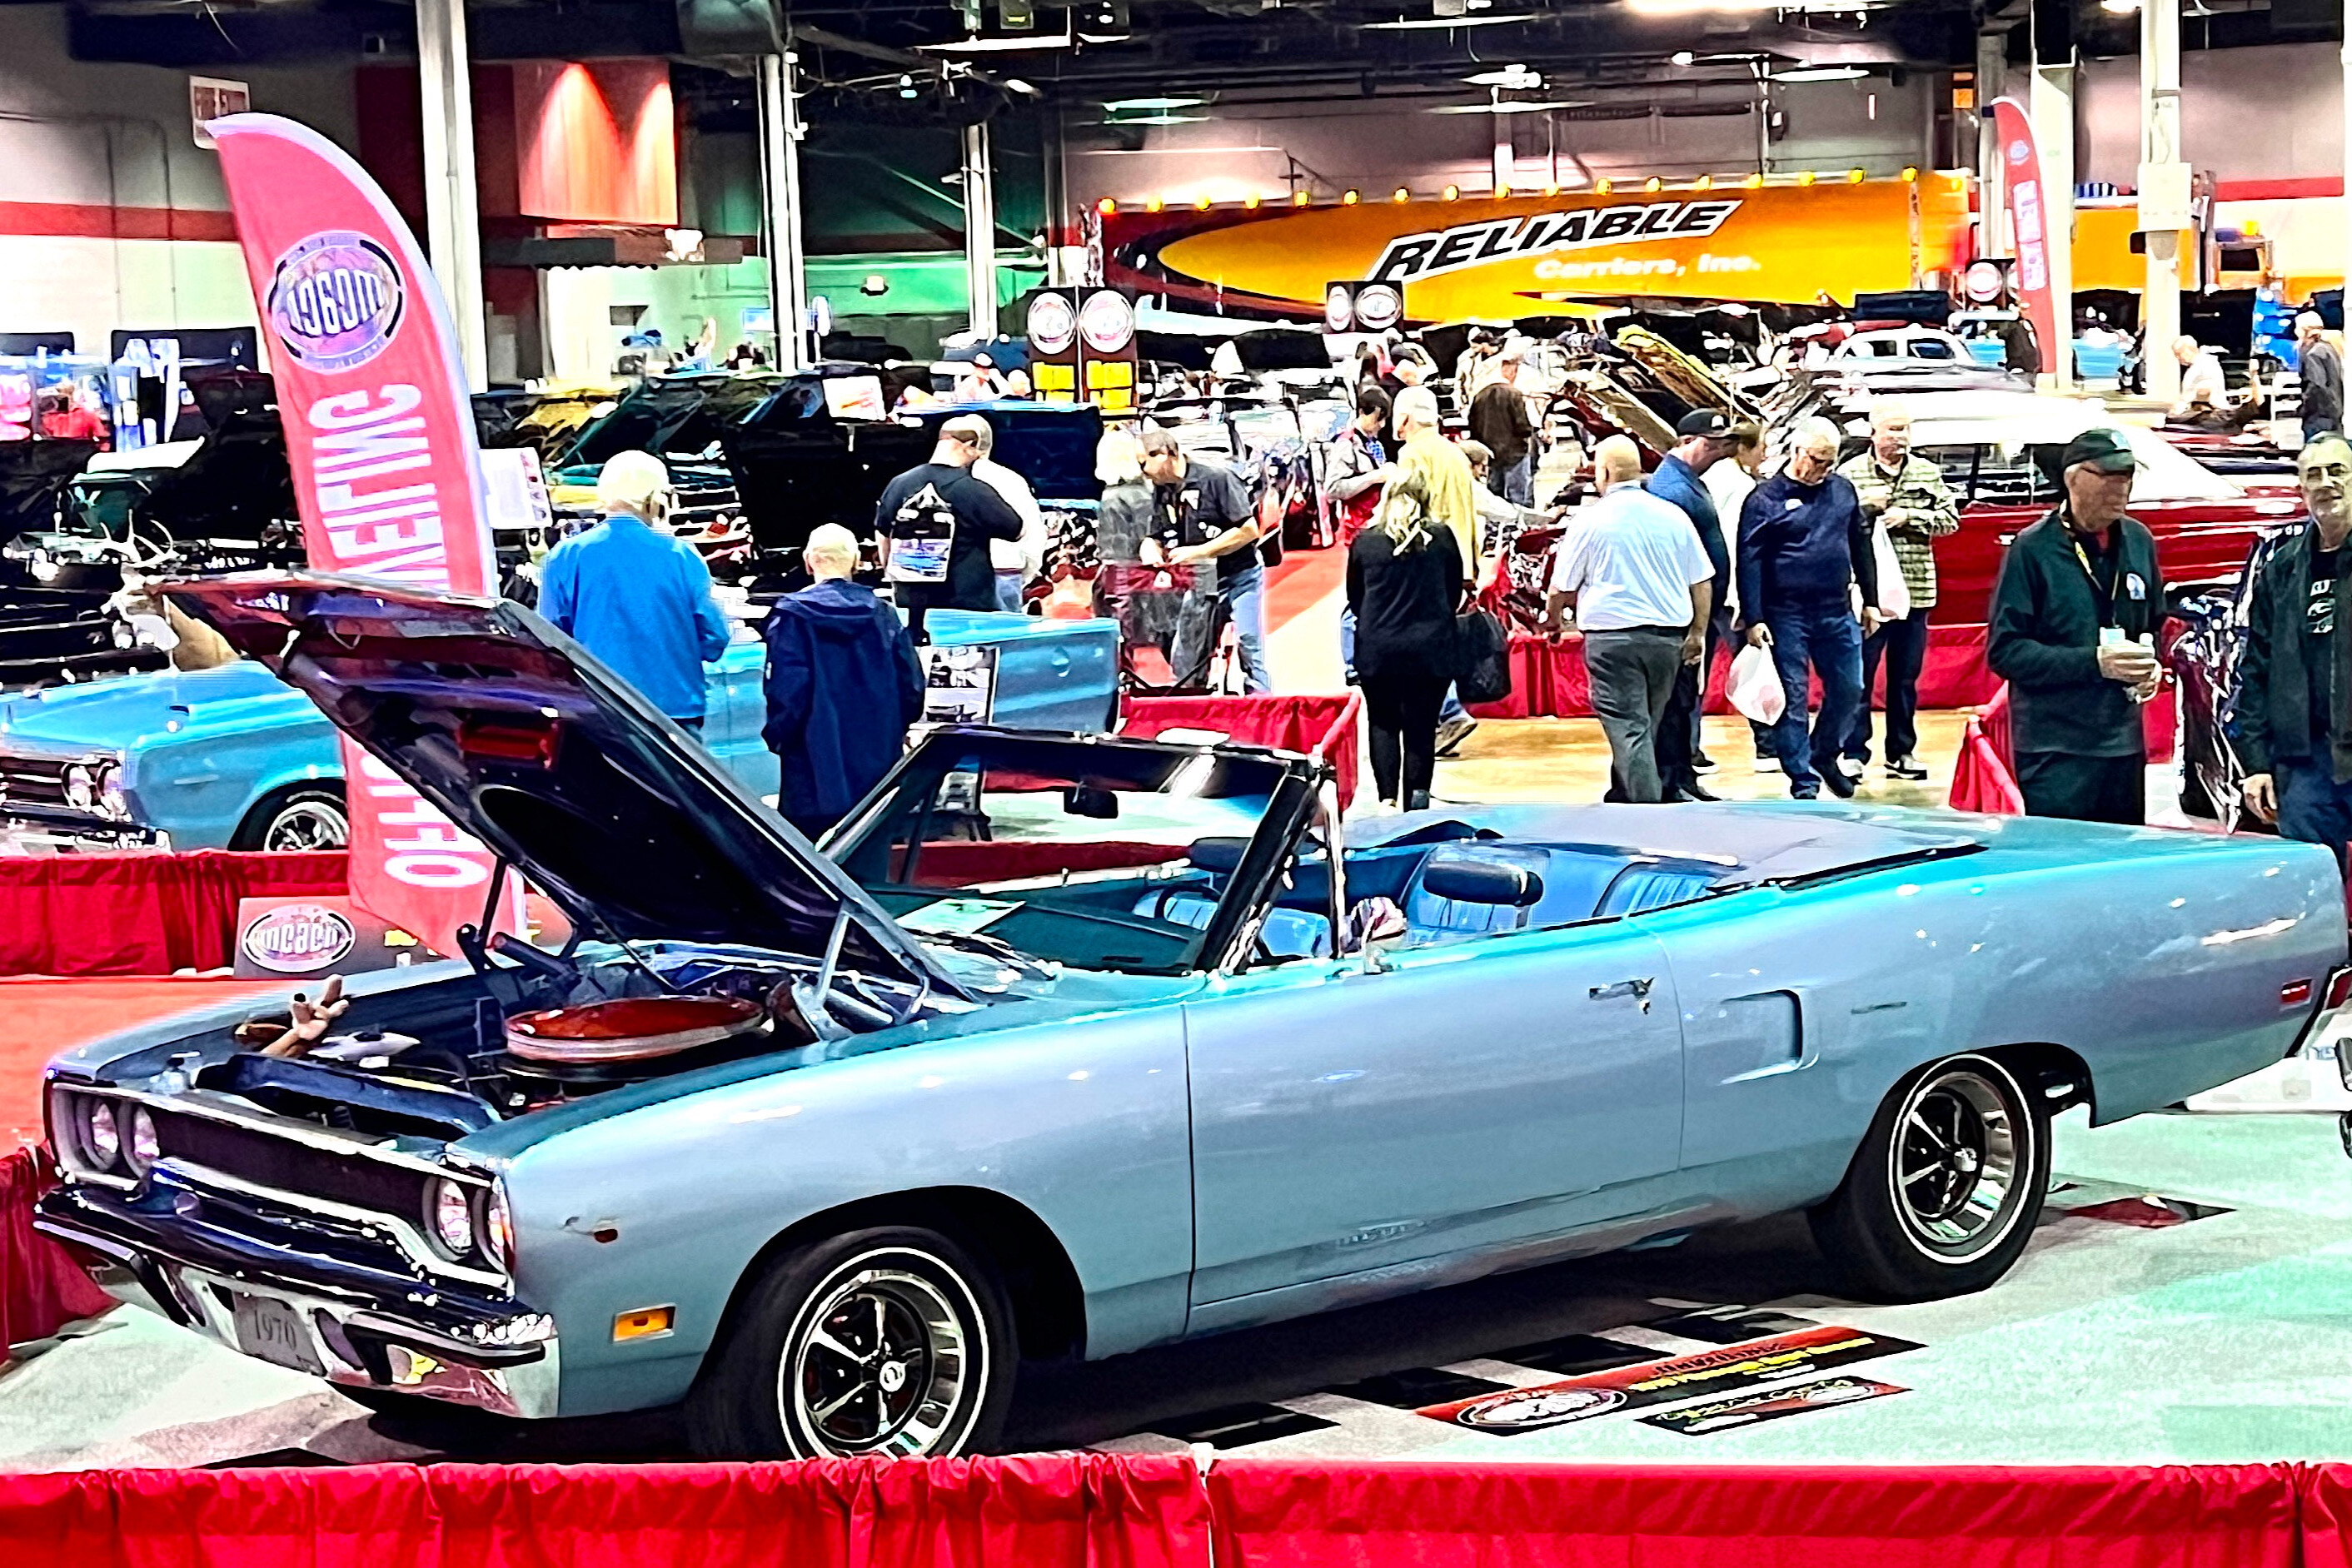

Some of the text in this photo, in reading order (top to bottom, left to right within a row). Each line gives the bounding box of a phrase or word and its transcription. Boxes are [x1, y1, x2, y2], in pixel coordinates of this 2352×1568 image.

[1368, 201, 1741, 282] RELIABLE
[1535, 254, 1762, 280] Carriers, Inc.
[254, 1310, 296, 1351] 1970
